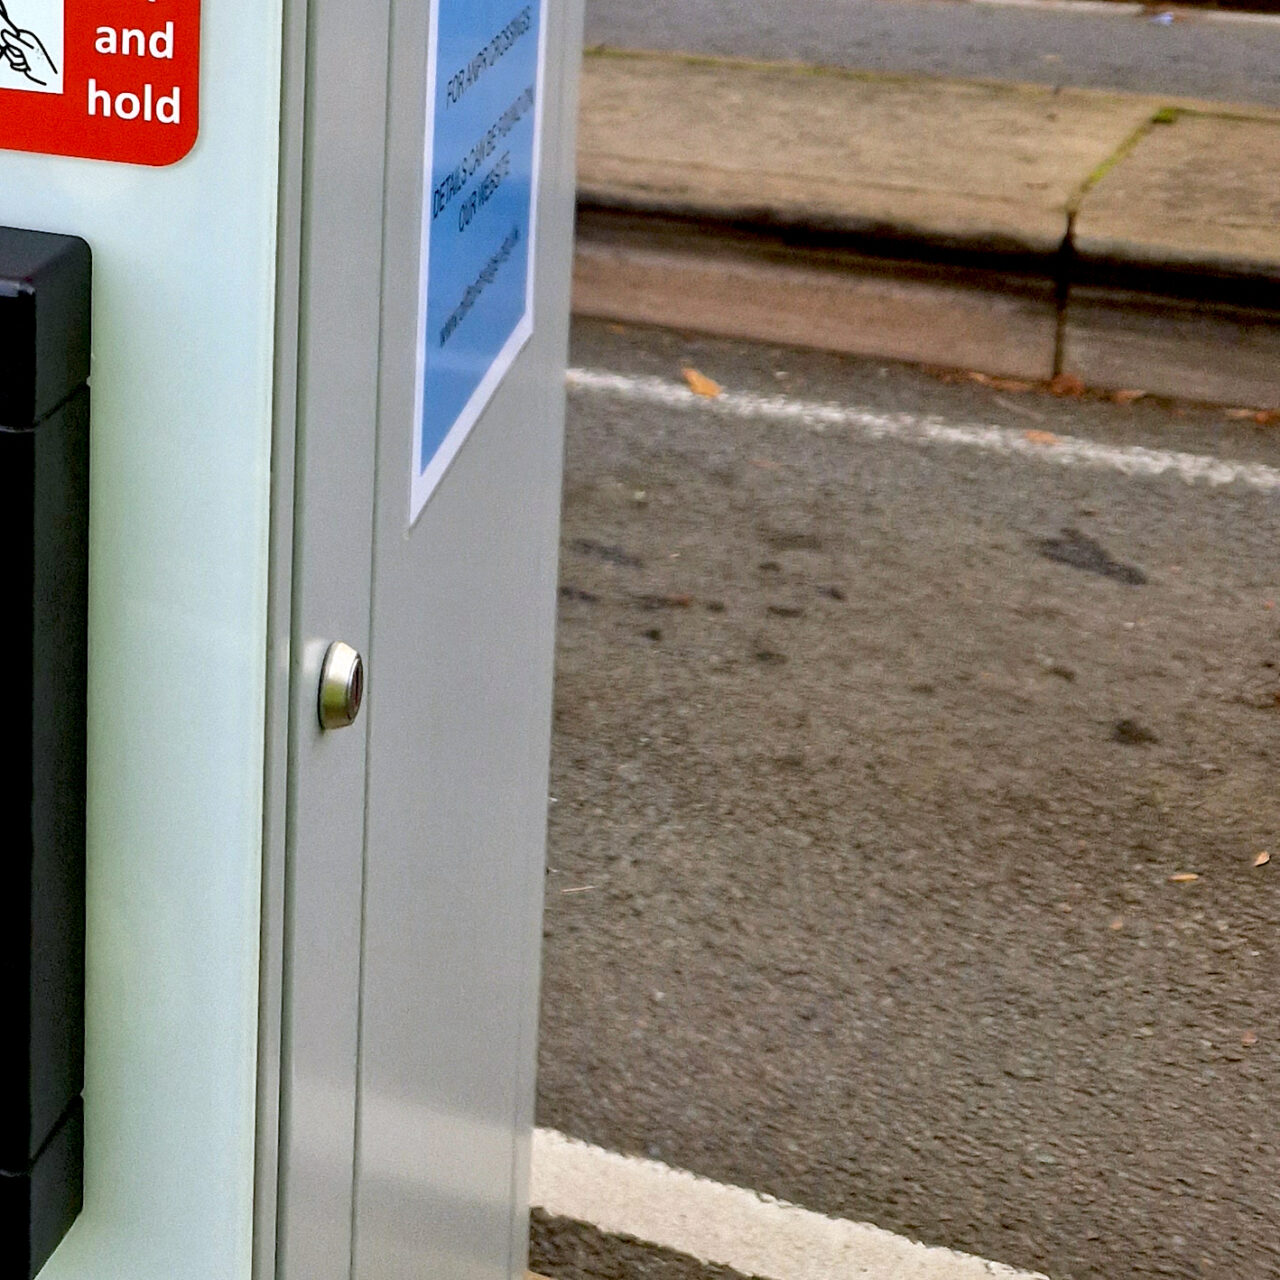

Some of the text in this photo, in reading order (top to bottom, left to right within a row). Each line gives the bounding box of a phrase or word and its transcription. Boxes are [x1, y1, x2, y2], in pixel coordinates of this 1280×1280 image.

[95, 21, 174, 59] and
[87, 78, 181, 124] hold
[446, 69, 465, 110] FOR
[433, 157, 467, 219] DETAILS
[459, 190, 477, 232] OUR
